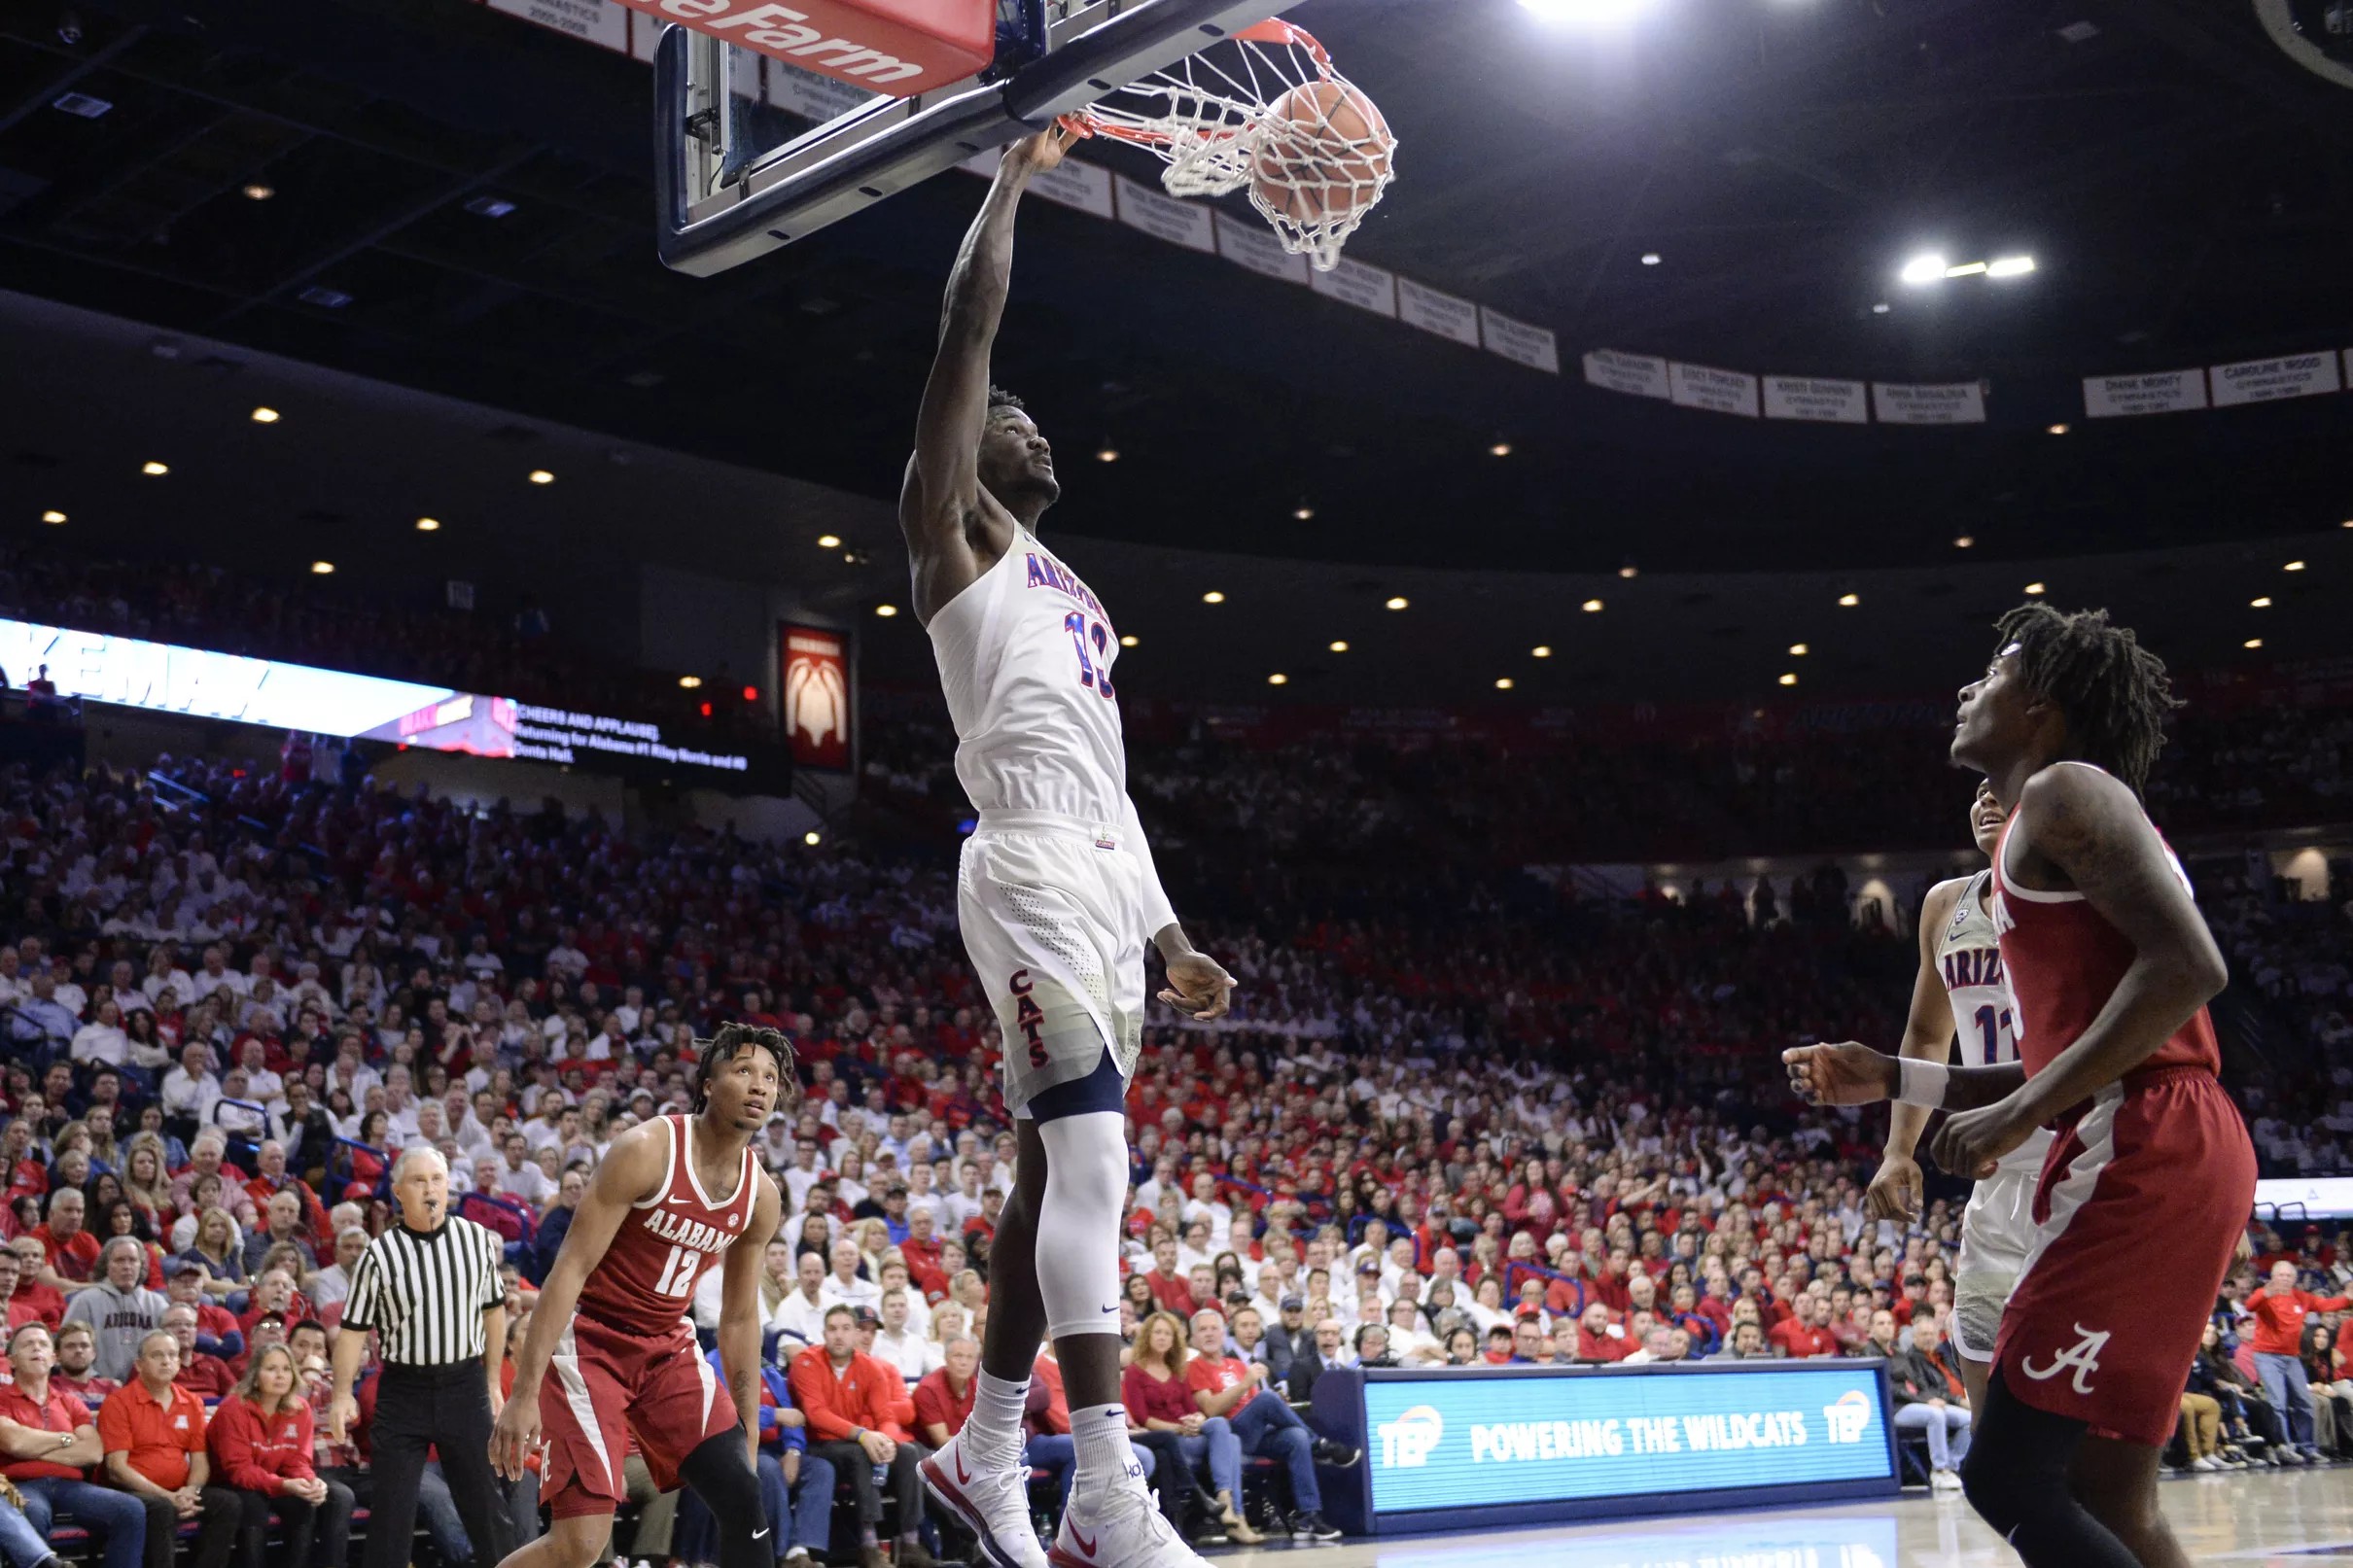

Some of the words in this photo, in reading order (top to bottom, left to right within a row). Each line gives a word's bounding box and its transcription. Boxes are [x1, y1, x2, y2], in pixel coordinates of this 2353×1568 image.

[704, 3, 924, 83] Farm
[568, 713, 594, 729] AND
[571, 730, 588, 746] for
[588, 733, 636, 754] Alabama
[1945, 949, 2005, 991] ARIZ
[1009, 968, 1049, 1067] CATS
[653, 1245, 701, 1298] 12
[1377, 1412, 1443, 1469] TEP
[1469, 1419, 1624, 1464] POWERING
[1627, 1416, 1681, 1454] THE
[1683, 1411, 1809, 1451] WILDCATS
[1822, 1397, 1871, 1445] TEP
